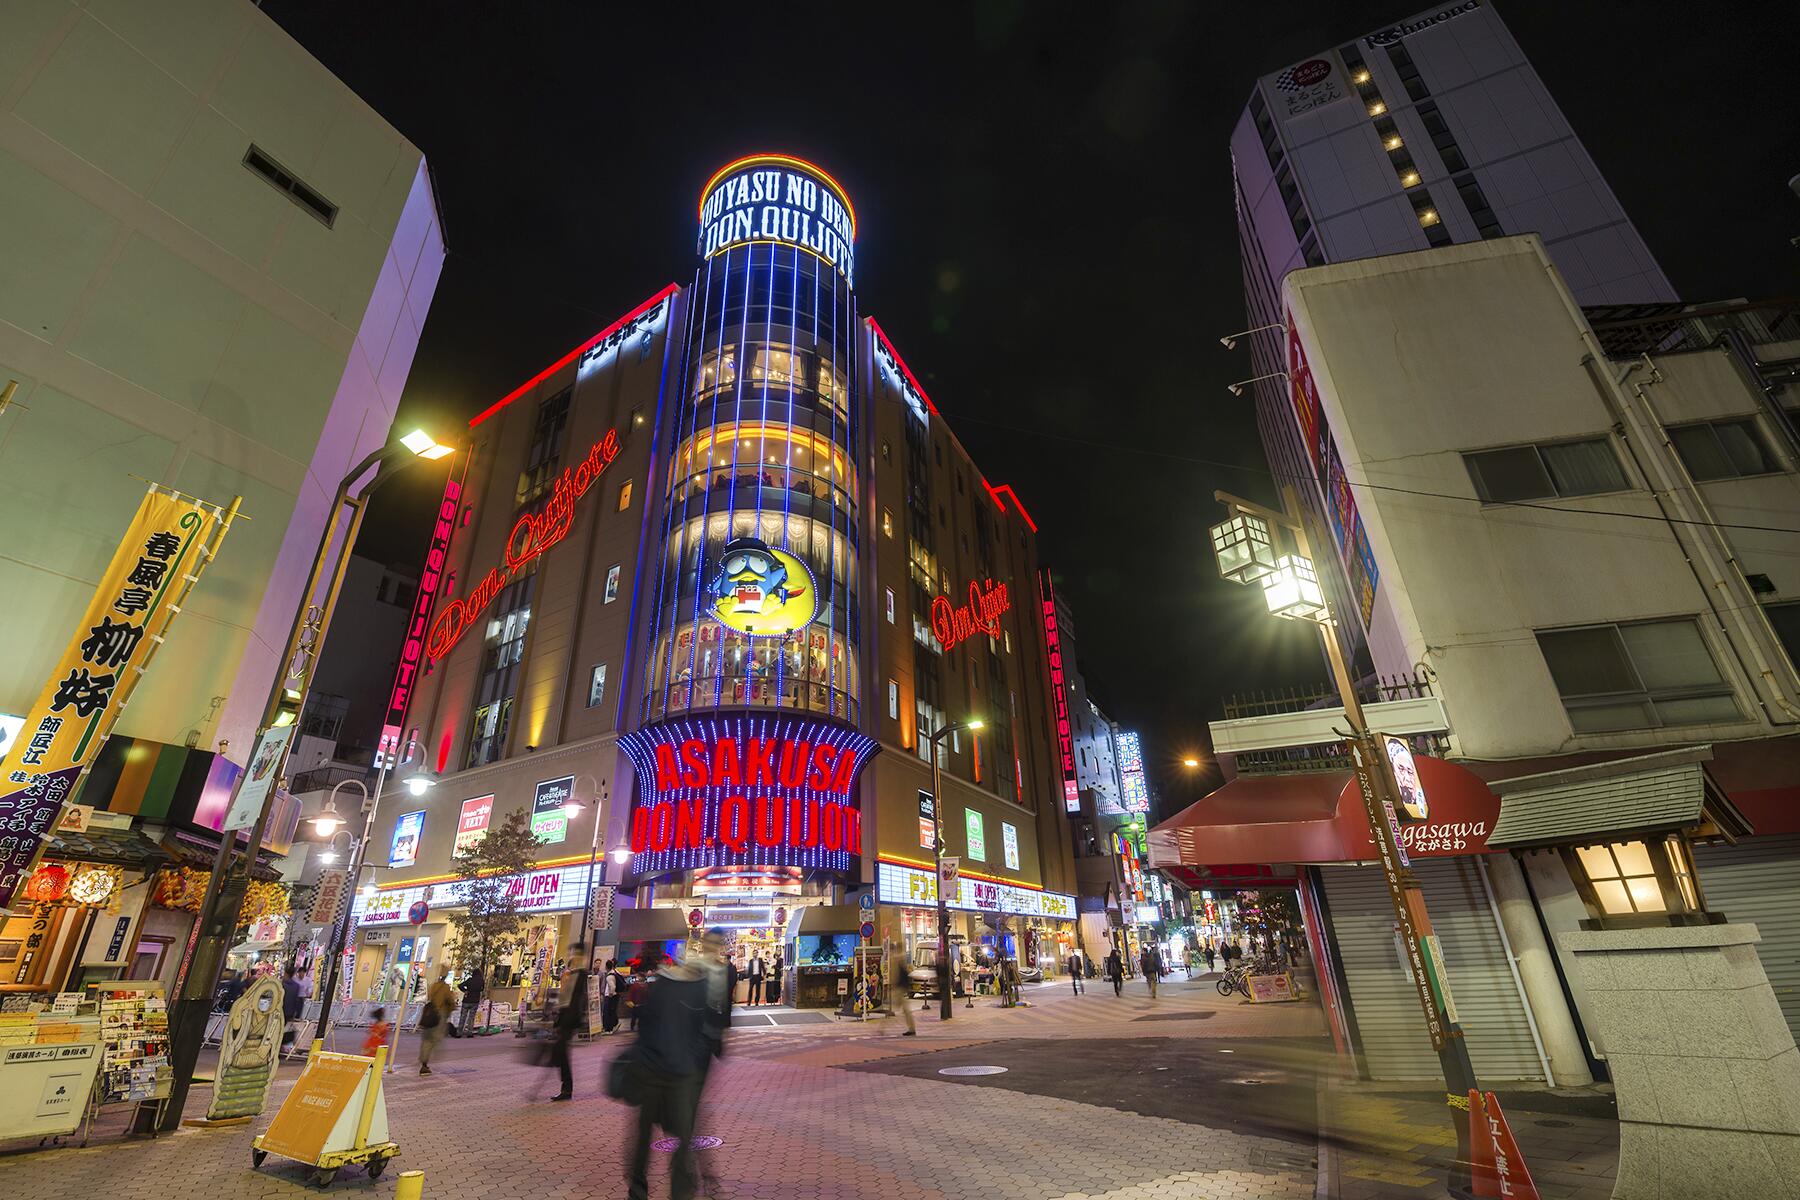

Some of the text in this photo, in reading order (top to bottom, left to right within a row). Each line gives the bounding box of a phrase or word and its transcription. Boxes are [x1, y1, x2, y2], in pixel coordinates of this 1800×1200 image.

[1363, 0, 1481, 49] Richmond
[700, 171, 781, 239] OUYASU
[786, 173, 817, 212] NO
[655, 737, 857, 795] ASAKUSA
[1415, 839, 1466, 852] ながさわ
[530, 873, 560, 894] OPEN
[1489, 1116, 1514, 1196] 立入禁止
